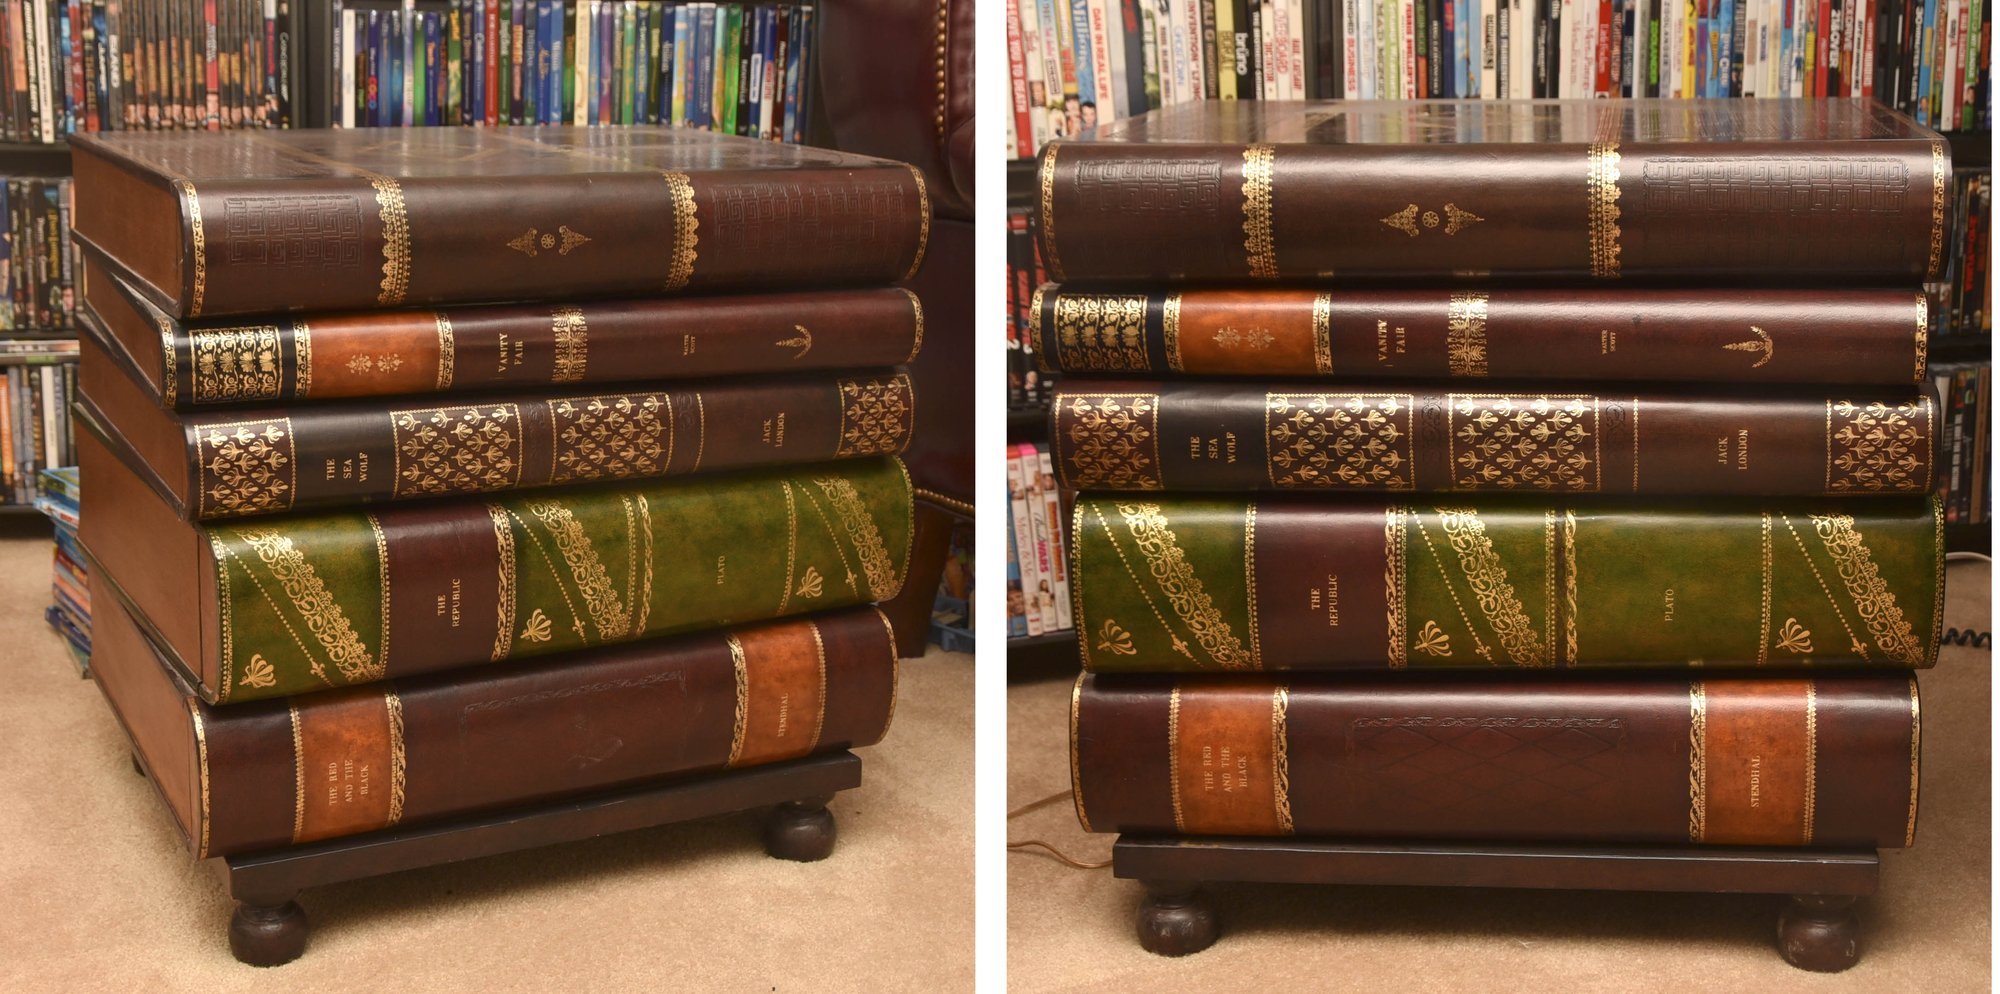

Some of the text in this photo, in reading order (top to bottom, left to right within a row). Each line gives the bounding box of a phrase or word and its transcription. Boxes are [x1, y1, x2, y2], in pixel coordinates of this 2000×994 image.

[1202, 1, 1215, 26] ALI
[1252, 11, 1260, 27] THE
[1915, 6, 1924, 24] 30
[1010, 40, 1022, 62] YOU
[1204, 29, 1216, 42] G
[1276, 10, 1289, 75] OVERBOARD
[1092, 8, 1109, 100] DAN IN REAL LIFE
[1235, 33, 1250, 76] brüno
[1346, 38, 1358, 92] BUSINESS
[1012, 64, 1023, 78] TO
[1014, 79, 1028, 113] DEATH
[498, 333, 508, 373] VANITY
[514, 341, 523, 365] FAIR
[1378, 319, 1388, 361] VANITY
[1396, 327, 1405, 353] FAIR
[763, 419, 771, 444] JACK
[775, 412, 785, 447] LONDON
[1191, 436, 1200, 459] THE
[1209, 438, 1218, 459] SEA
[1226, 432, 1236, 463] WOLF
[1718, 437, 1728, 464] JACK
[1738, 429, 1748, 470] LONDON
[326, 459, 336, 480] THE
[343, 459, 352, 479] SEA
[359, 452, 368, 482] WOLF
[717, 556, 726, 585] PLATO
[1036, 540, 1050, 574] WARS
[438, 595, 446, 616] THE
[452, 579, 461, 627] REPUBLIC
[1311, 588, 1320, 610] THE
[1328, 574, 1338, 626] REPUBLIC
[1664, 588, 1674, 621] PLATO
[778, 692, 789, 737] STENDHAL
[329, 762, 337, 806] THE RED
[345, 760, 353, 802] AND THE
[360, 765, 369, 795] BLACK
[1203, 746, 1213, 791] THE RED
[1220, 746, 1232, 793] AND THE
[1237, 756, 1247, 788] BLACK
[1750, 755, 1760, 808] STENDHAL
